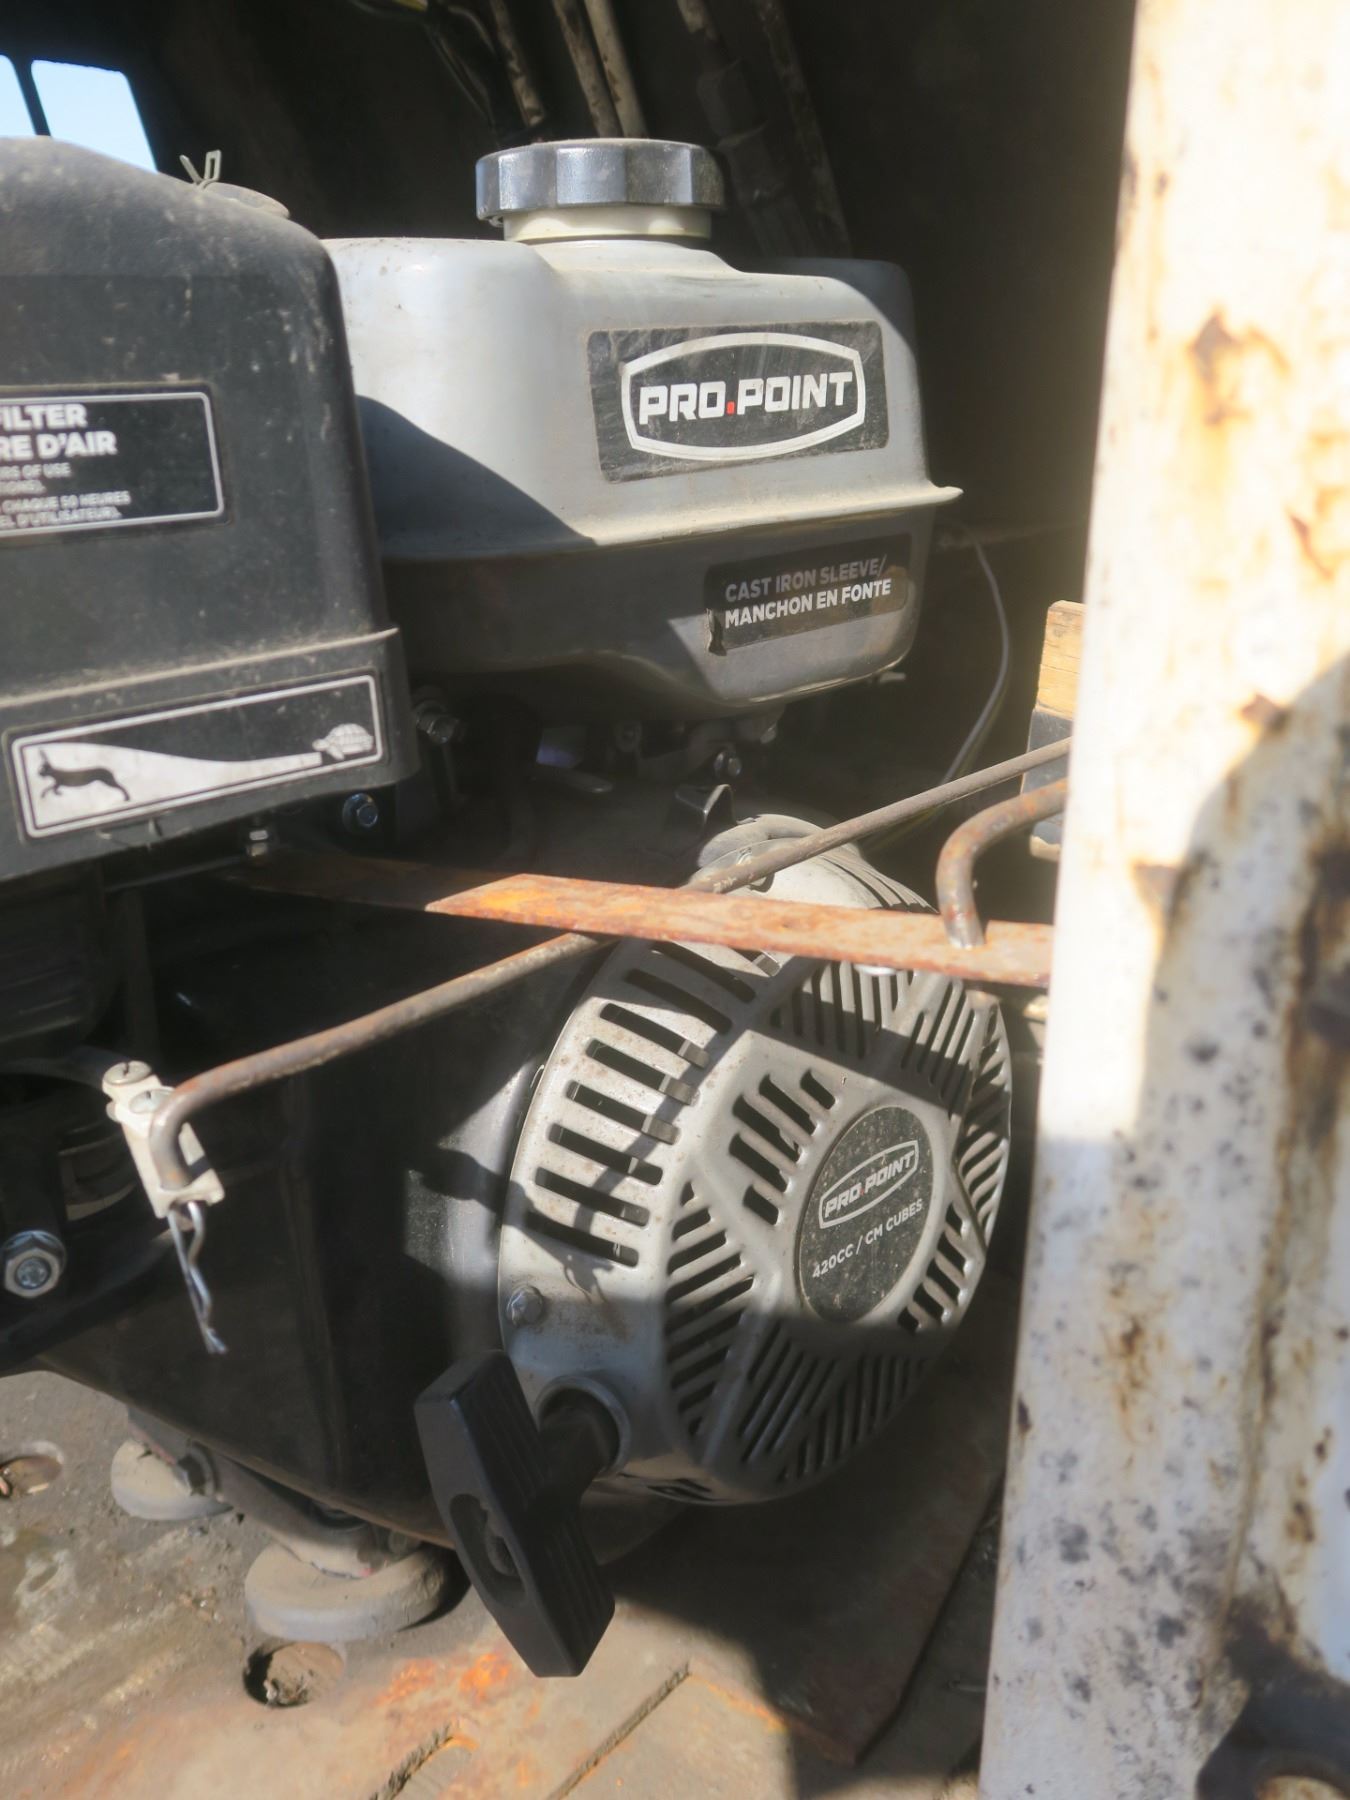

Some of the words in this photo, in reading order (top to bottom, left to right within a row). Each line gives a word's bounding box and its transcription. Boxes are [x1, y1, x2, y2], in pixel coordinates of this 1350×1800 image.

[639, 371, 853, 425] PRO.POINT
[0, 404, 88, 431] ILTER
[36, 431, 118, 459] D'AIR
[43, 462, 72, 478] USE
[79, 490, 131, 507] HEURES
[725, 577, 772, 602] CAST
[776, 568, 817, 593] IRON
[819, 554, 887, 584] SLEEVE/
[725, 592, 813, 629] MANCHON
[816, 588, 839, 609] EN
[841, 578, 892, 605] FONTE
[812, 1243, 854, 1278] 420CC
[865, 1224, 883, 1245] CM
[886, 1198, 923, 1231] CUBES
